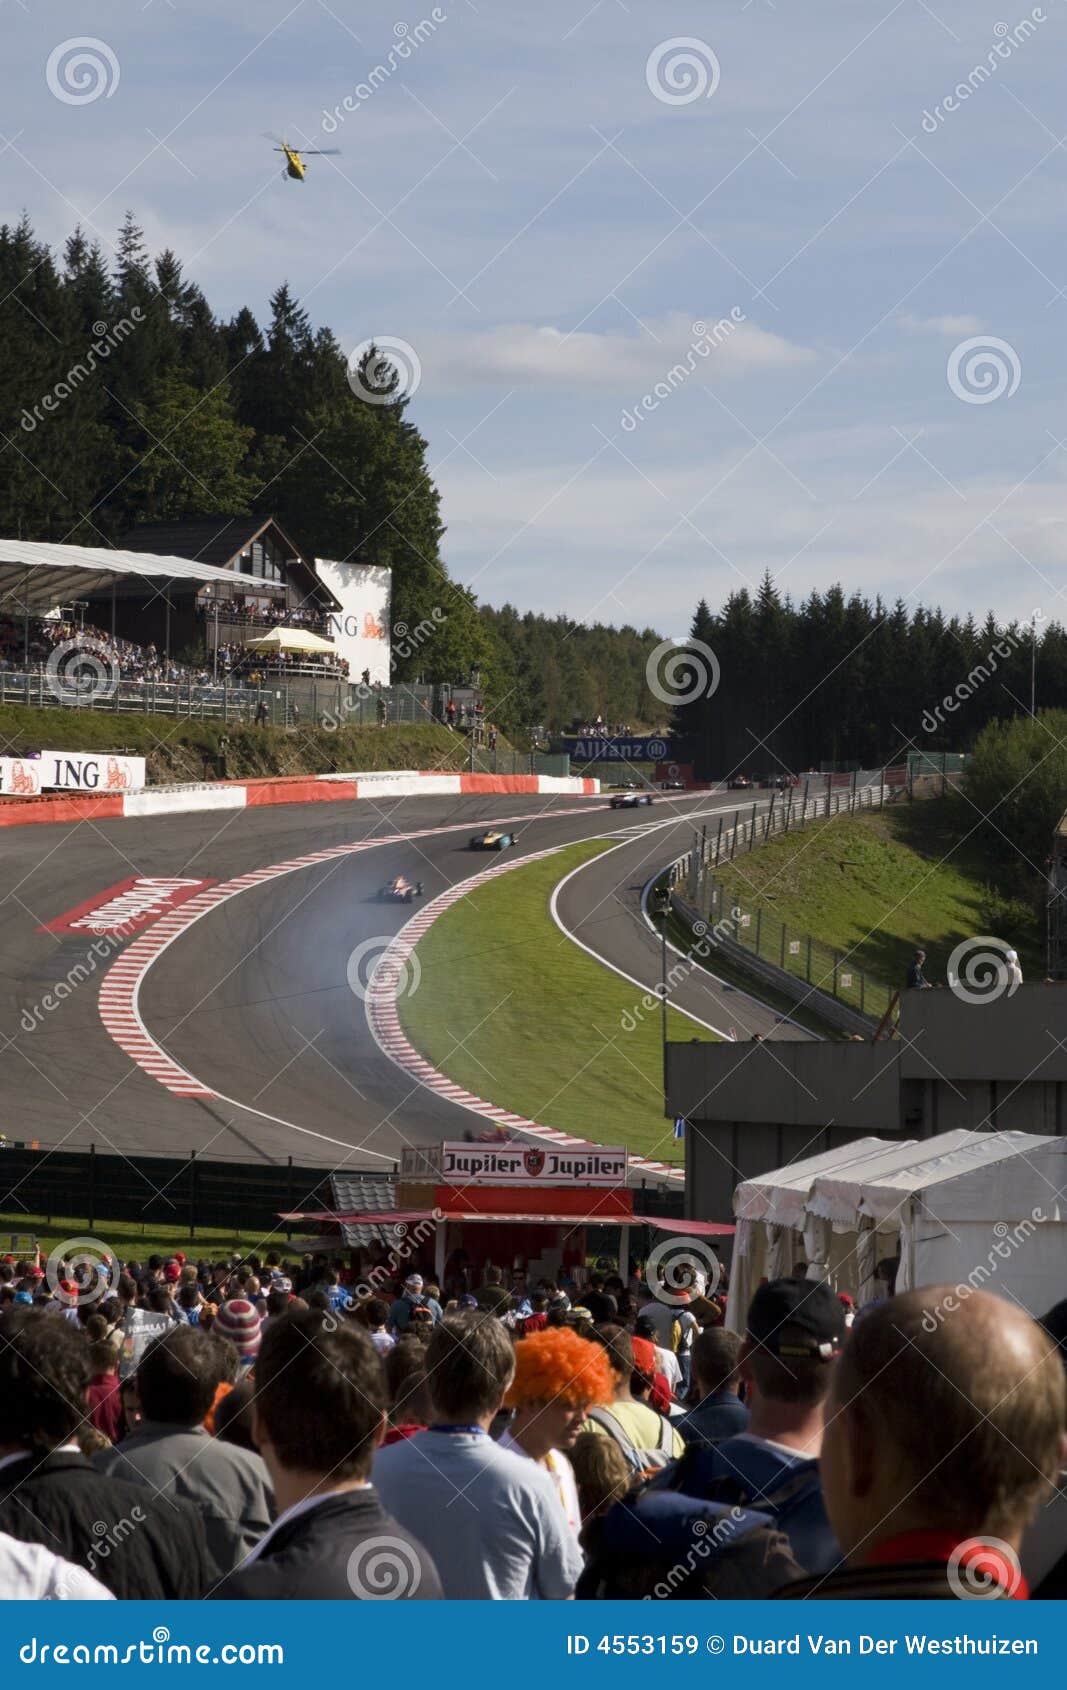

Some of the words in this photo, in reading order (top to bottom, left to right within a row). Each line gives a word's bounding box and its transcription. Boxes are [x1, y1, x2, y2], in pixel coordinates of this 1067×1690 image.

[329, 613, 358, 637] NG
[574, 740, 643, 757] Allianz
[54, 759, 100, 788] ING
[445, 1153, 521, 1175] Jupiler
[549, 1155, 624, 1178] Jupiler
